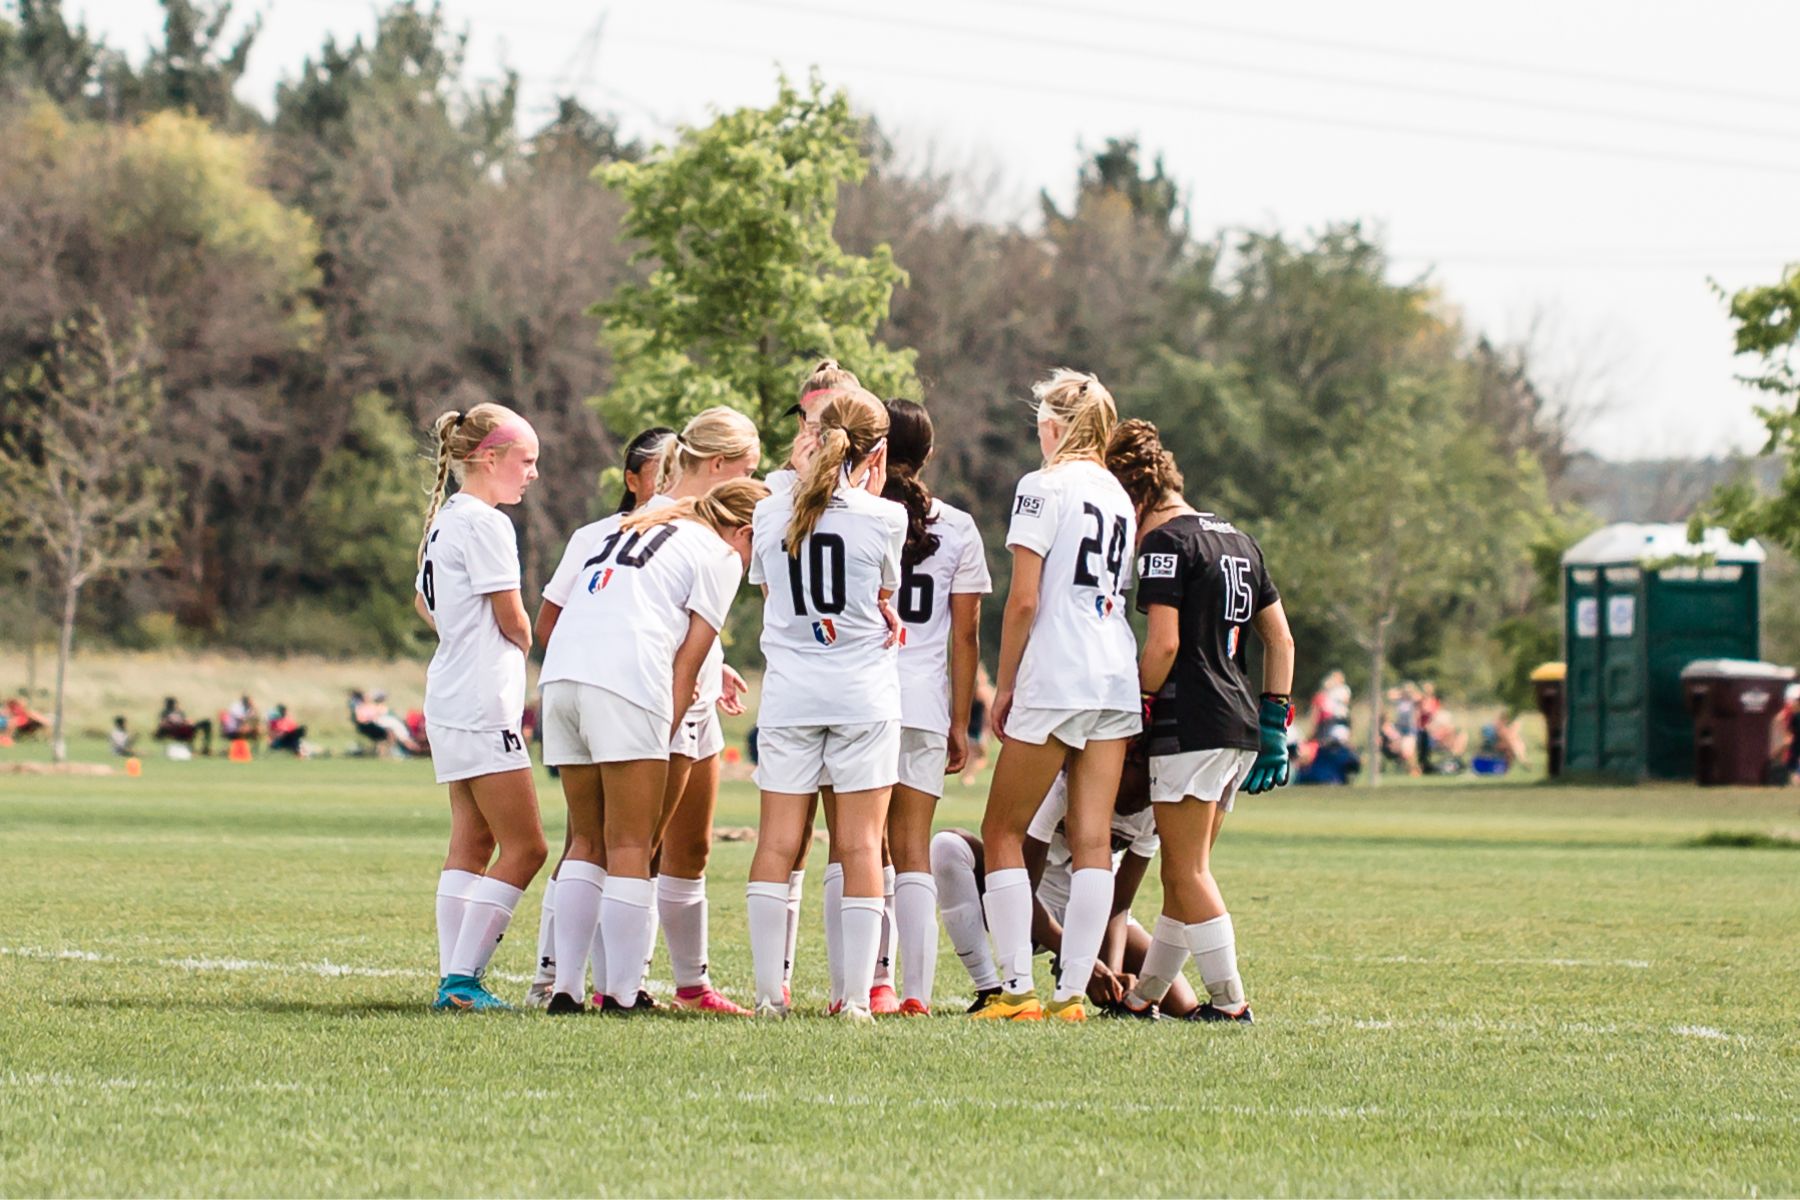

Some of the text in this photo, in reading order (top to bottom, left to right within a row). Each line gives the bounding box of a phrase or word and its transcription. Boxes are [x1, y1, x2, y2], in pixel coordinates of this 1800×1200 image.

[1023, 497, 1040, 510] 65
[782, 532, 846, 617] 10
[1073, 501, 1127, 597] 24
[1152, 555, 1174, 569] 65
[1220, 554, 1252, 623] 15
